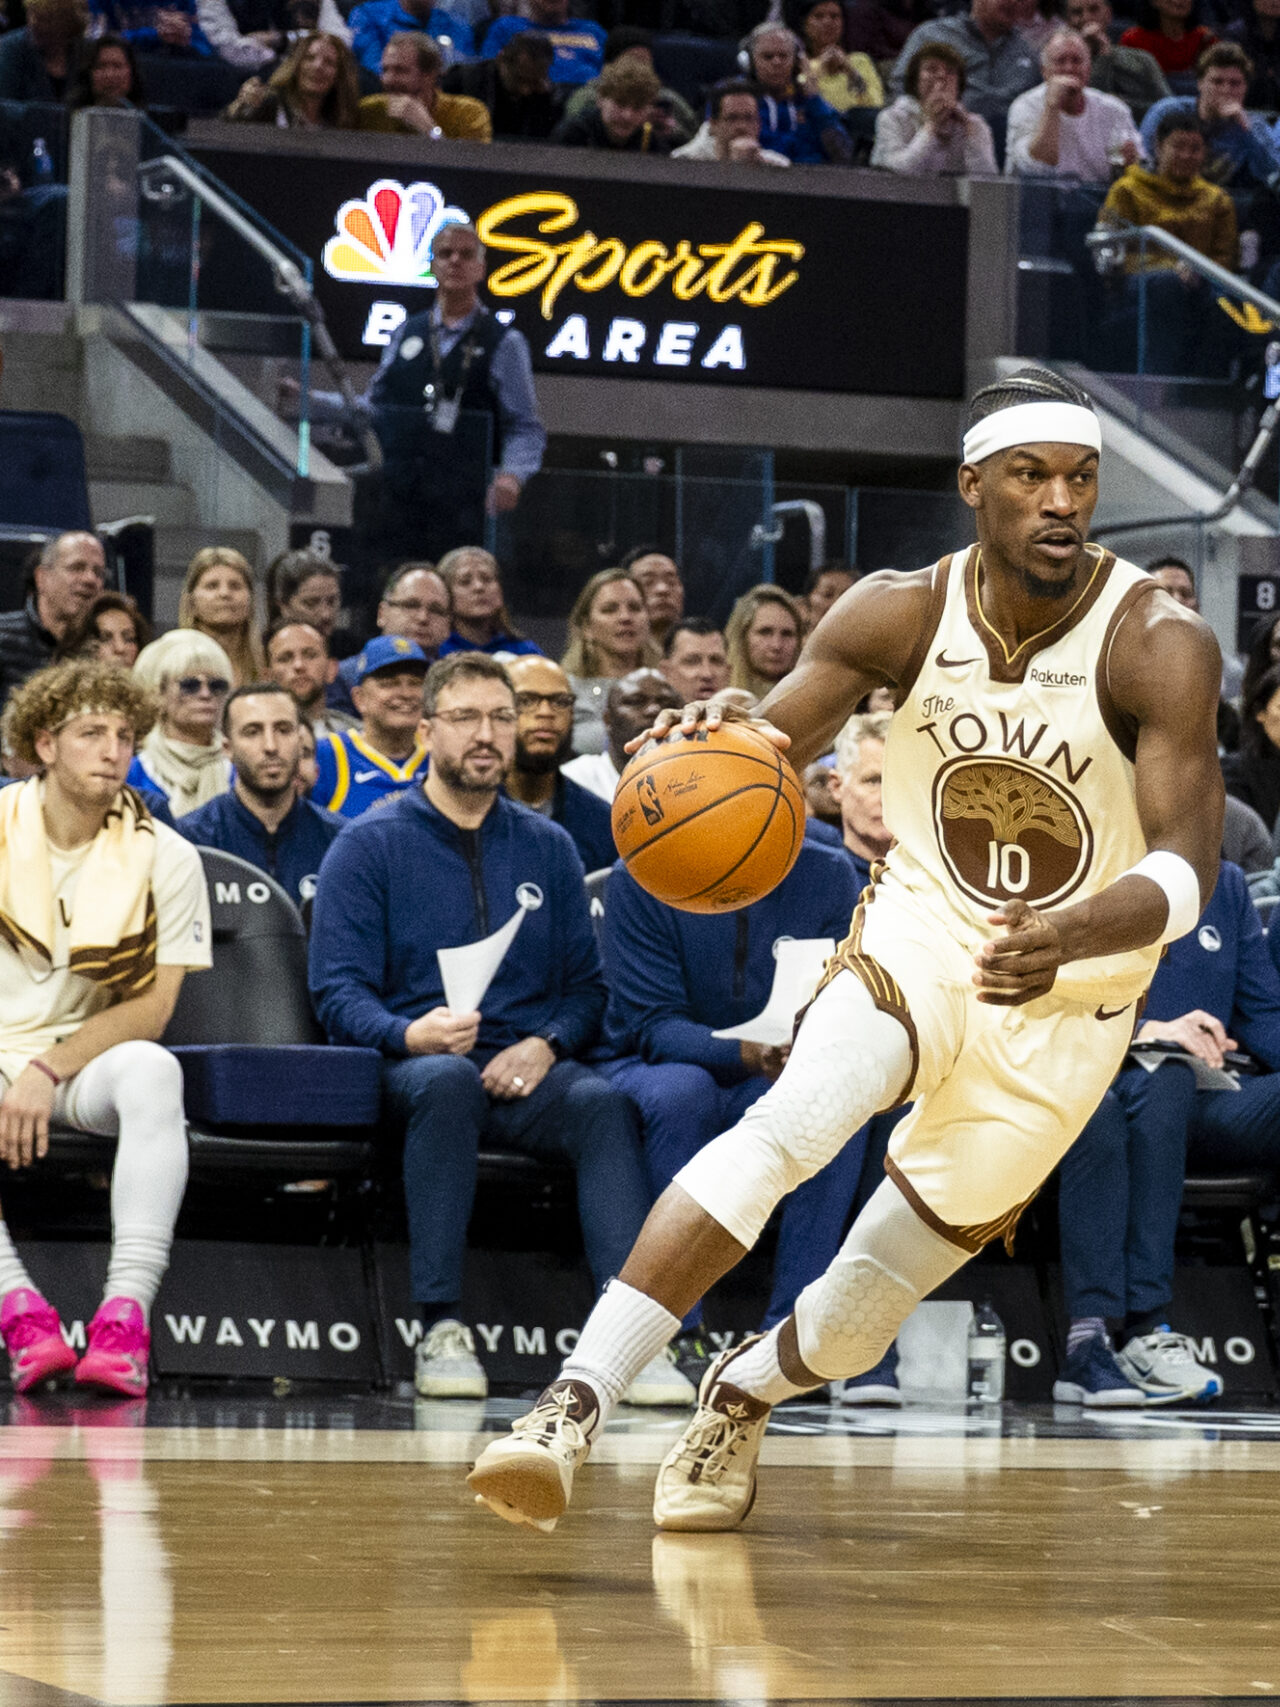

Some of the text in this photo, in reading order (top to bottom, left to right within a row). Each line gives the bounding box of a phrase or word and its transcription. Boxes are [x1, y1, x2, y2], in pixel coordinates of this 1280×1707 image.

[476, 191, 805, 320] Sports
[545, 313, 747, 370] AREA
[1256, 581, 1276, 610] 8
[1030, 668, 1087, 687] Rakuten
[921, 694, 955, 719] The
[916, 711, 1093, 786] TOWN
[986, 840, 1031, 894] 10
[165, 1313, 361, 1352] WAYMO
[394, 1317, 581, 1356] WYMO
